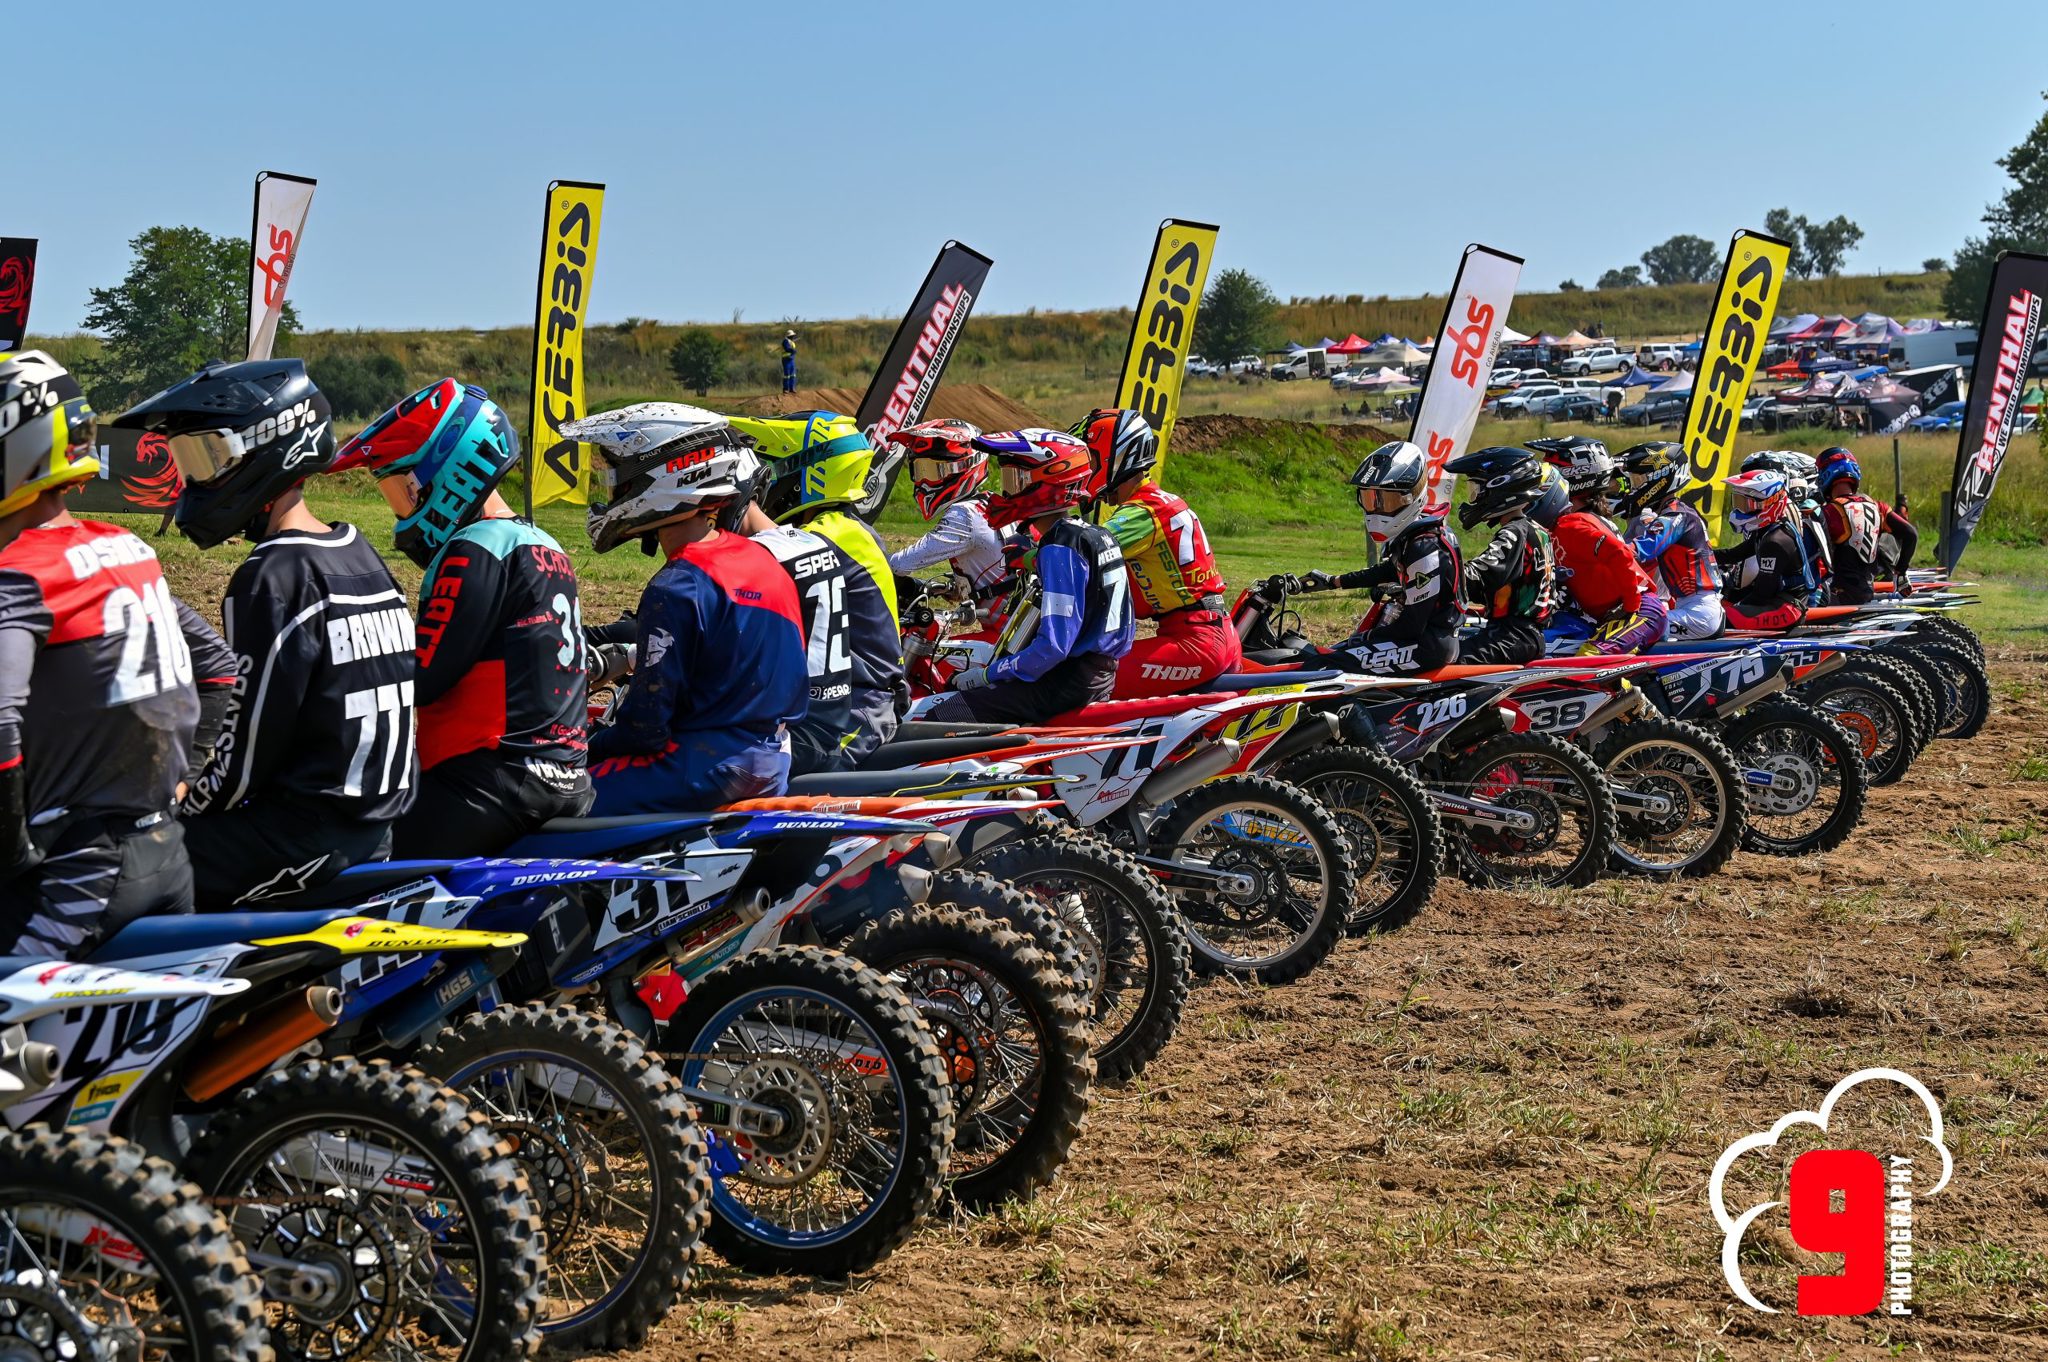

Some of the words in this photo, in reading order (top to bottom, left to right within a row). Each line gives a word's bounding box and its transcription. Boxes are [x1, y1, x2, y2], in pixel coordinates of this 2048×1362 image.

[1446, 296, 1494, 389] sbs
[1490, 330, 1502, 356] AHEAD
[2014, 297, 2041, 395] CHAMPIONSHIPS
[872, 282, 965, 450] RENTHAL
[904, 414, 916, 430] WE
[914, 380, 930, 410] BUILD
[928, 292, 971, 382] CHAMPIONSHIPS
[1977, 288, 2032, 475] RENTHAL
[240, 399, 316, 451] 100%
[2003, 395, 2018, 427] BUILD
[1998, 427, 2009, 448] WE
[677, 467, 712, 488] KTM
[1637, 478, 1668, 507] ROCKSTAR
[1860, 503, 1876, 562] UFO
[1154, 540, 1192, 606] FESTOOL
[733, 588, 762, 601] THOR
[1414, 590, 1430, 602] LEATT
[103, 575, 193, 708] 210
[326, 607, 417, 666] BROWN
[1141, 663, 1202, 681] THOR
[1361, 643, 1419, 670] LEATT
[1699, 659, 1720, 670] YAMAHA
[1720, 653, 1765, 694] 75
[1416, 692, 1468, 732] 226
[1530, 700, 1587, 731] 38
[344, 680, 415, 797] 777
[773, 821, 845, 830] DUNLOP
[510, 869, 598, 887] DUNLOP
[615, 857, 691, 934] 31
[658, 916, 677, 931] LIAM
[676, 902, 710, 923] SCHOLTZ
[367, 938, 459, 948] DUNLOP
[439, 971, 474, 1004] HGS
[333, 1155, 375, 1178] YAMAHA
